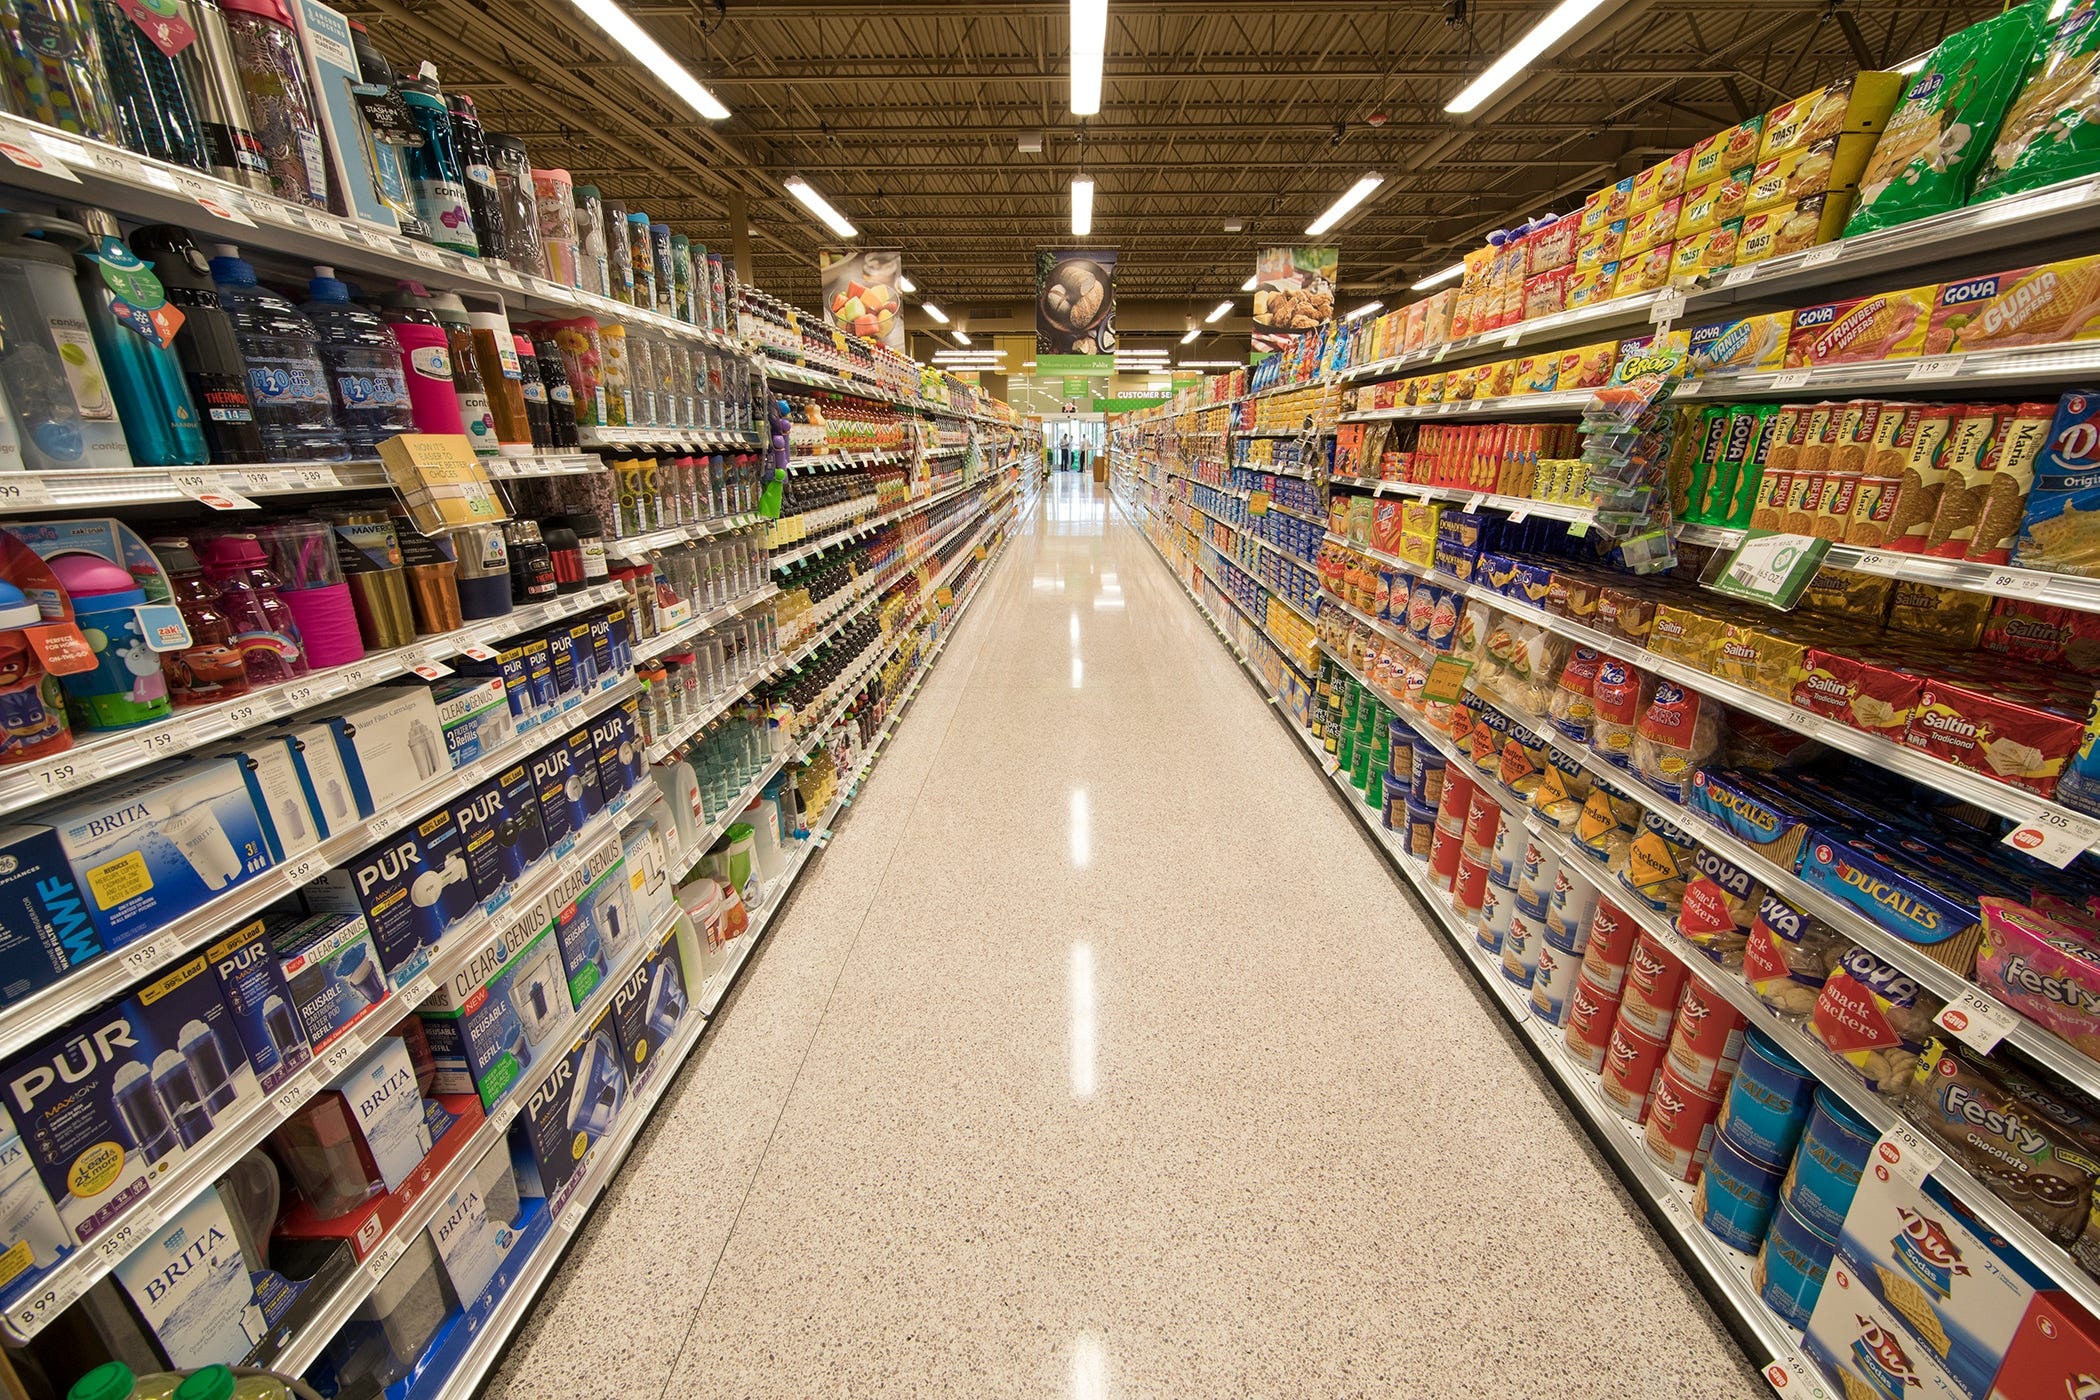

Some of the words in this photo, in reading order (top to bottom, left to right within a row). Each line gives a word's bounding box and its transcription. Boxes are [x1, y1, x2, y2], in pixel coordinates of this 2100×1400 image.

[1772, 124, 1798, 142] TOAST
[1698, 152, 1719, 169] TOAST
[1746, 235, 1770, 250] TOAST
[1944, 280, 1996, 304] GOYA
[1984, 272, 2058, 332] GUAVA
[1798, 308, 1834, 326] GOYA
[2009, 290, 2054, 330] WAFERS
[1694, 326, 1720, 340] GOYA
[1710, 323, 1750, 362] VANILLA
[1816, 298, 1887, 358] STRAWBERRY
[1838, 317, 1874, 349] WAFERS
[290, 376, 310, 386] the
[291, 370, 306, 378] on
[374, 384, 390, 392] the
[375, 378, 387, 386] on
[226, 410, 239, 419] 14
[1776, 416, 1790, 441] Maria
[1807, 414, 1821, 440] Maria
[1839, 412, 1854, 440] Maria
[1860, 406, 1878, 440] IBERIA
[1878, 414, 1894, 444] Maria
[1900, 410, 1920, 446] IBERIA
[1729, 415, 1752, 460] GOYA
[1912, 425, 1934, 462] Maria
[1956, 424, 1978, 463] Maria
[2008, 424, 2038, 467] Maria
[1758, 480, 1770, 503] Maria
[1775, 476, 1792, 506] IBERIA
[1806, 478, 1823, 508] IBERIA
[1837, 481, 1854, 513] IBERIA
[1856, 488, 1872, 516] Maria
[45, 635, 73, 646] PERFECT
[158, 624, 181, 636] zak!
[442, 702, 464, 722] CLEAR
[471, 688, 494, 708] GENIUS
[1814, 692, 1846, 707] Tradicional
[356, 718, 374, 730] Water
[374, 712, 390, 724] Filter
[390, 702, 418, 720] Cartridges
[1923, 712, 1976, 736] Saltín
[447, 732, 456, 750] 3
[456, 732, 478, 746] Refills
[1931, 732, 1975, 750] Tradicional
[1950, 755, 1959, 766] 2
[87, 802, 151, 838] BRITA
[1713, 788, 1778, 832] DUCALES
[631, 836, 650, 858] BRITA
[2015, 832, 2042, 846] save
[104, 860, 129, 875] REDUCES
[553, 878, 584, 908] CLEAR
[588, 840, 619, 878] GENIUS
[1696, 848, 1749, 894] GOYA
[561, 906, 577, 922] NEW
[1844, 870, 1942, 930] DUCALES
[36, 876, 102, 966] MWF
[243, 925, 260, 941] Lead
[564, 917, 590, 948] REUSABLE
[1593, 906, 1619, 934] Dux
[44, 924, 60, 948] FILTER
[308, 941, 334, 964] CLEAR
[339, 918, 365, 944] GENIUS
[54, 942, 70, 972] WATER
[288, 958, 304, 972] NEW
[455, 947, 500, 998] CLEAR
[506, 904, 546, 954] GENIUS
[570, 951, 586, 972] REFILL
[1635, 944, 1666, 975] Dux
[182, 962, 202, 979] Lead
[302, 982, 342, 1019] REUSABLE
[466, 990, 488, 1012] NEW
[1684, 984, 1710, 1018] Dux
[2005, 957, 2100, 1016] Festy
[1574, 988, 1600, 1017] Dux
[1827, 984, 1870, 1020] snack
[2028, 998, 2099, 1033] Strawberry
[308, 1016, 328, 1034] FILTER
[328, 1007, 341, 1020] POD
[470, 1000, 507, 1042] REUSABLE
[1819, 993, 1878, 1041] crackers
[1944, 1013, 1966, 1030] save
[312, 1022, 334, 1042] REFILL
[1611, 1030, 1640, 1060] Dux
[478, 1041, 502, 1069] REFILL
[360, 1065, 412, 1120] BRITA
[1656, 1078, 1686, 1114] Dux
[1946, 1083, 2047, 1154] Festy
[78, 1151, 108, 1176] Lead
[1880, 1143, 1900, 1163] save
[1966, 1132, 2030, 1172] Chocolate
[74, 1174, 92, 1187] 2x
[92, 1155, 118, 1176] more
[364, 1224, 375, 1238] 5
[438, 1191, 478, 1242] BRITA
[1899, 1208, 1968, 1276] Dux
[142, 1224, 226, 1306] BRITA
[1904, 1248, 1938, 1282] Sodas
[1984, 1260, 2000, 1276] 27
[1859, 1316, 1920, 1386] Dux
[1770, 1368, 1786, 1386] save
[1863, 1354, 1892, 1389] Sodas
[1933, 1376, 1948, 1390] 27
